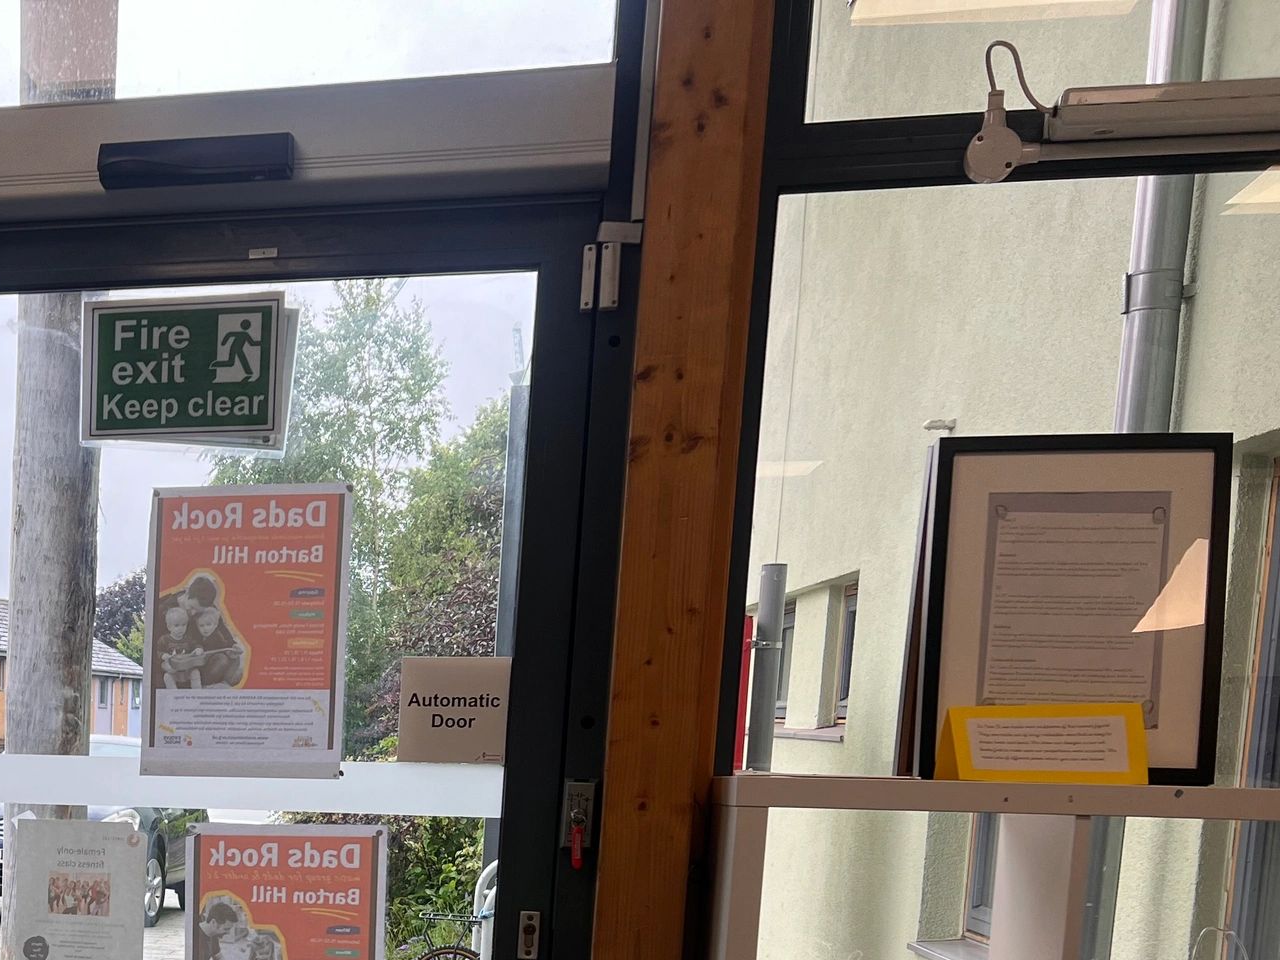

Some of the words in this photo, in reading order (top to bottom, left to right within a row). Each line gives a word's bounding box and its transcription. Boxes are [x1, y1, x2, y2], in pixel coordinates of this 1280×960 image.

[114, 319, 190, 351] Fire
[111, 352, 185, 386] exit
[102, 392, 179, 425] Keep
[187, 390, 265, 417] clear
[407, 692, 501, 708] Automatic
[431, 713, 476, 729] Door
